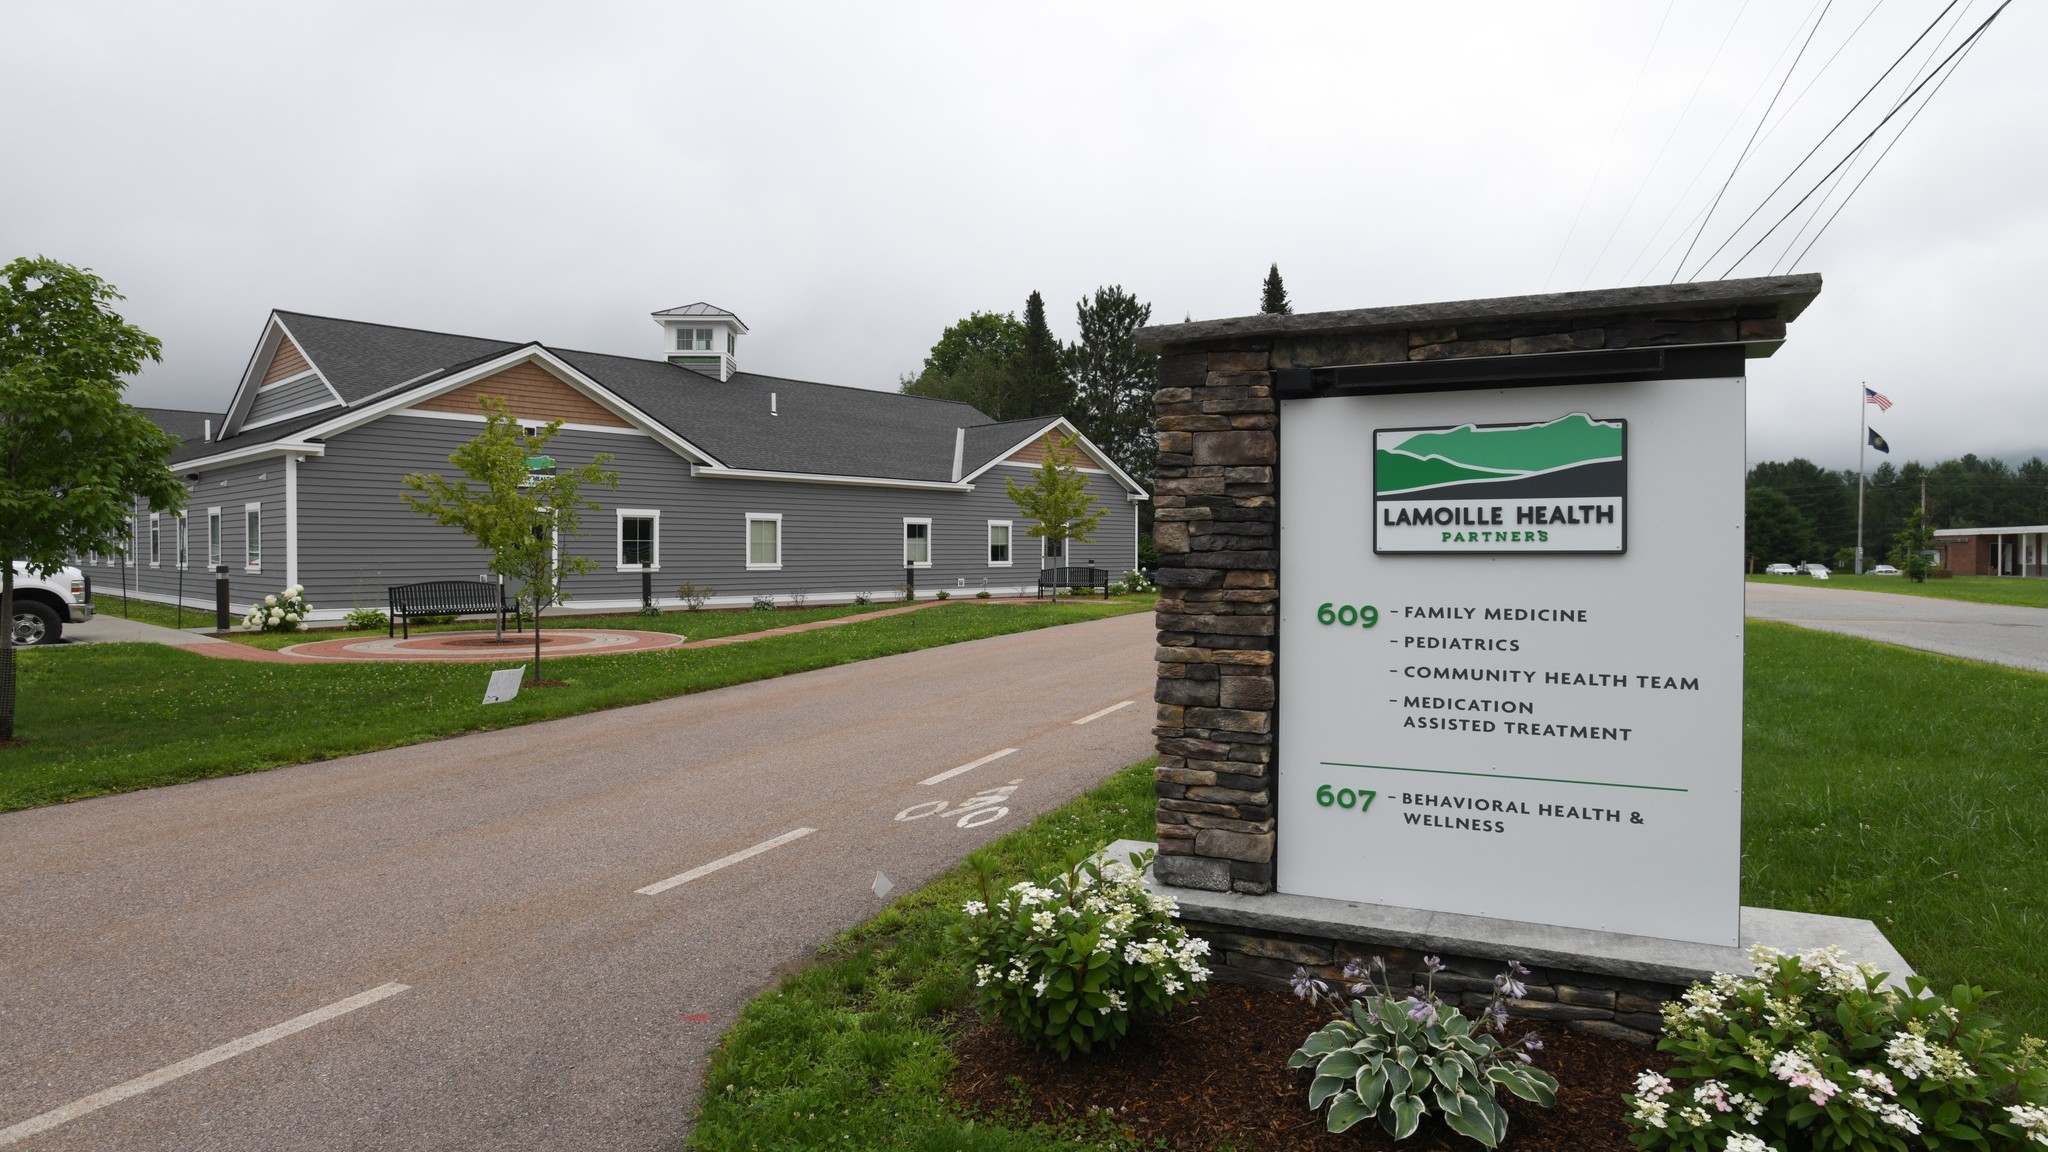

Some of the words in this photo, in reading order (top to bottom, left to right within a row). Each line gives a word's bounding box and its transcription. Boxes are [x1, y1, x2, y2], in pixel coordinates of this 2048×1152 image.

[1384, 506, 1503, 527] LAMOILLE
[1516, 504, 1614, 525] HEALTH
[1441, 530, 1549, 543] PARTNERS
[1317, 602, 1379, 628] 609
[1405, 606, 1476, 620] FAMILY
[1484, 608, 1588, 623] MEDICINE
[1404, 636, 1520, 652] PEDIATRICS
[1404, 666, 1537, 684] COMMUNITY
[1545, 672, 1627, 688] HEALTH
[1636, 675, 1699, 691] TEAM
[1403, 696, 1534, 715] MEDICATION
[1403, 716, 1496, 733] ASSISTED
[1503, 721, 1632, 741] TREATMENT
[1316, 784, 1377, 812] 607
[1402, 792, 1531, 815] BEHAVIORAL
[1538, 803, 1621, 823] HEALTH
[1629, 811, 1644, 825] &
[1403, 812, 1505, 833] WELLNESS
